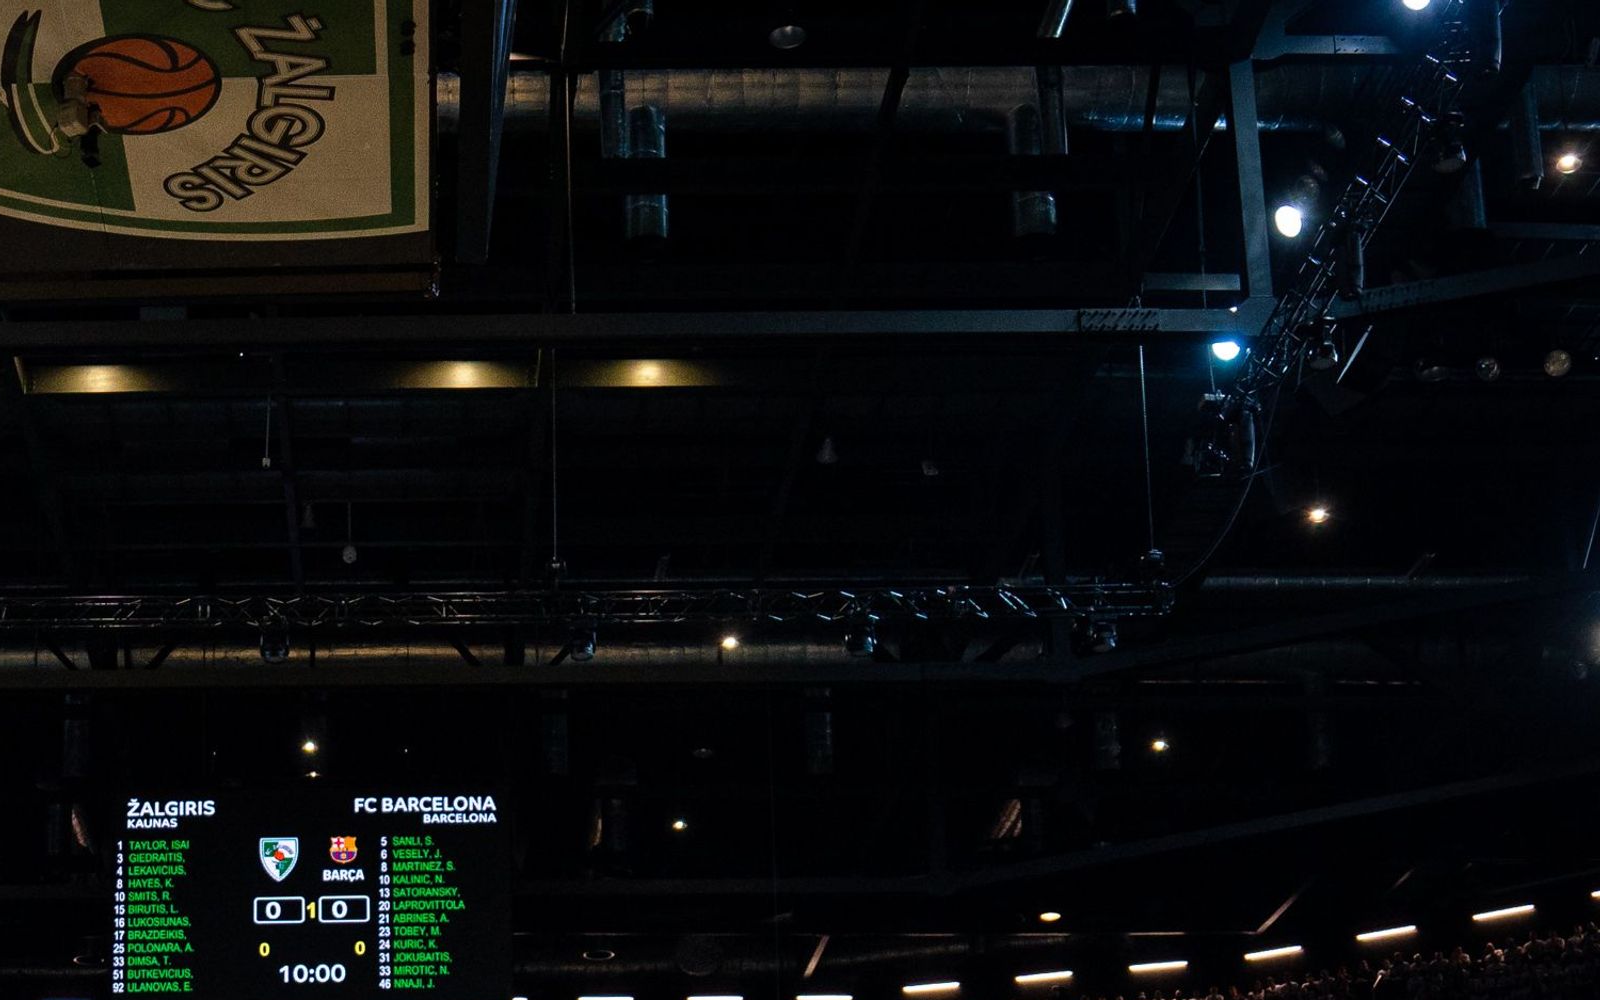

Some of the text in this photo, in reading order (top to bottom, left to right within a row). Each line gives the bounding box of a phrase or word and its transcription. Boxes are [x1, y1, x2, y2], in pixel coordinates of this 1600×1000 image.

[127, 798, 215, 816] ŽALGIRIS
[354, 796, 497, 813] FC BARCELONA
[127, 818, 178, 828] KAUNAS
[423, 813, 497, 824] BARCELONA
[118, 841, 122, 850] 1
[381, 837, 387, 846] 5
[117, 853, 123, 863] 3
[381, 850, 387, 859] 6
[117, 866, 123, 876] 4
[381, 862, 387, 872] 8
[323, 869, 365, 882] BARÇA
[379, 875, 390, 885] 10
[116, 879, 123, 888] 8
[115, 892, 125, 901] 10
[379, 888, 390, 898] 13
[115, 905, 125, 914] 15
[266, 902, 281, 919] 0
[307, 902, 316, 919] 1
[332, 901, 348, 918] 0
[379, 900, 465, 911] 20 LAPROVITTOLA
[115, 918, 125, 927] 16
[379, 914, 390, 923] 21
[115, 931, 124, 940] 17
[379, 927, 390, 936] 23
[113, 943, 125, 953] 25
[259, 942, 270, 956] 0
[354, 941, 366, 955] 0
[379, 939, 390, 949] 24
[113, 957, 124, 966] 33
[379, 953, 390, 962] 31
[113, 969, 124, 979] 51
[279, 964, 346, 983] 10:00
[379, 965, 390, 975] 33
[113, 983, 124, 993] 92
[379, 978, 391, 989] 46
